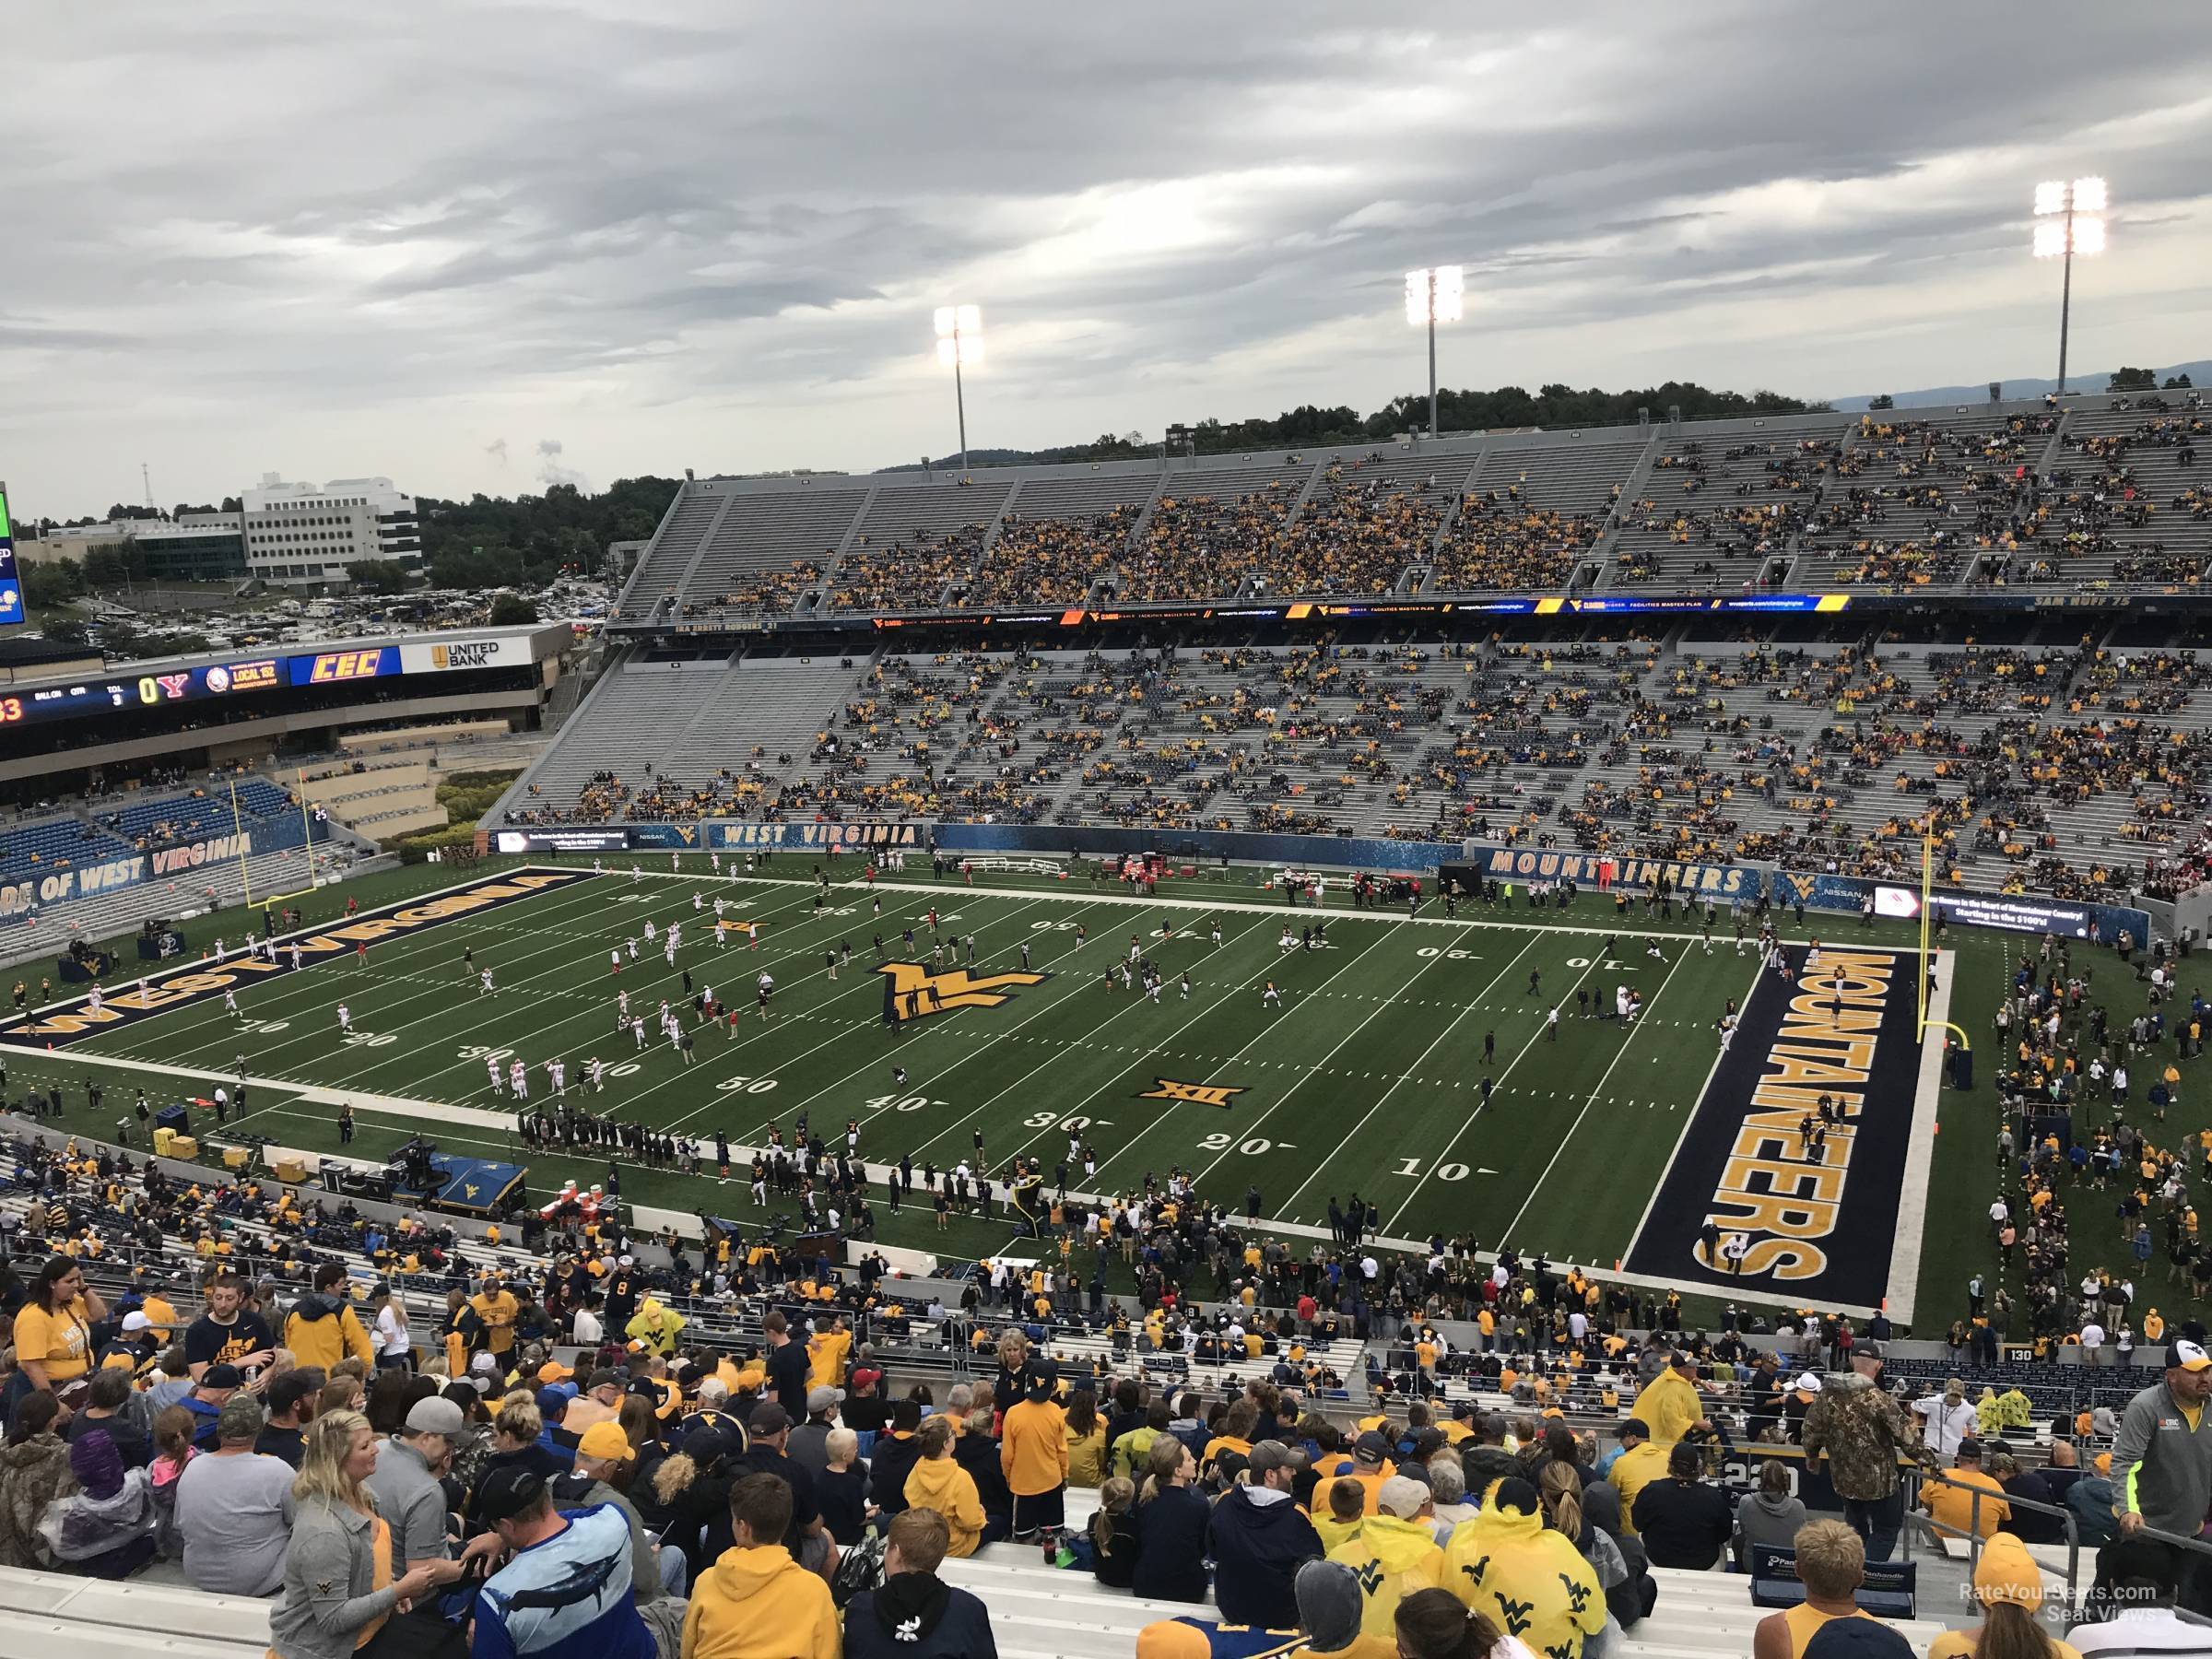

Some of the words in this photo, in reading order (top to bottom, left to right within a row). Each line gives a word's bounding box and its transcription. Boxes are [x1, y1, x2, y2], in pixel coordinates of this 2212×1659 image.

[2035, 597, 2065, 606] SAM
[2112, 597, 2131, 606] 75
[448, 642, 499, 655] UNITED
[313, 652, 378, 679] CEC
[449, 654, 487, 666] BANK
[233, 668, 260, 682] LOCAL
[260, 666, 275, 678] 152
[70, 687, 86, 695] QTR
[139, 678, 158, 704] 0
[157, 674, 188, 698] Y
[316, 810, 327, 821] 25
[725, 826, 786, 843] WEST
[803, 825, 915, 843] VIRGINIA
[41, 873, 73, 900] OF
[80, 857, 144, 891] WEST
[152, 832, 252, 875] VIRGINIA
[1823, 889, 1862, 898] NISSAN
[288, 871, 577, 959] VIRGINIA
[1939, 897, 1960, 906] Homes
[1969, 900, 1980, 908] the
[1982, 901, 1999, 910] Heart
[2001, 902, 2008, 911] of
[2008, 904, 2052, 916] Mountaineer
[2053, 909, 2083, 921] Country!
[1956, 908, 1990, 920] Starting
[2001, 913, 2015, 922] the
[1030, 920, 1077, 932] 50
[1416, 947, 1473, 960] 20
[1566, 958, 1623, 971] 10
[3, 959, 284, 1035] WEST
[241, 1018, 290, 1034] 10
[348, 1031, 398, 1048] 20
[715, 1076, 779, 1094] 50
[865, 1094, 928, 1112] 40
[1023, 1112, 1091, 1132] 30
[1692, 950, 1896, 1281] MOUNTAINEERS
[1196, 1134, 1272, 1155] 20
[1392, 1157, 1470, 1181] 10
[617, 1282, 627, 1295] 8
[2011, 1350, 2031, 1362] 130
[1725, 1463, 1798, 1497] 20
